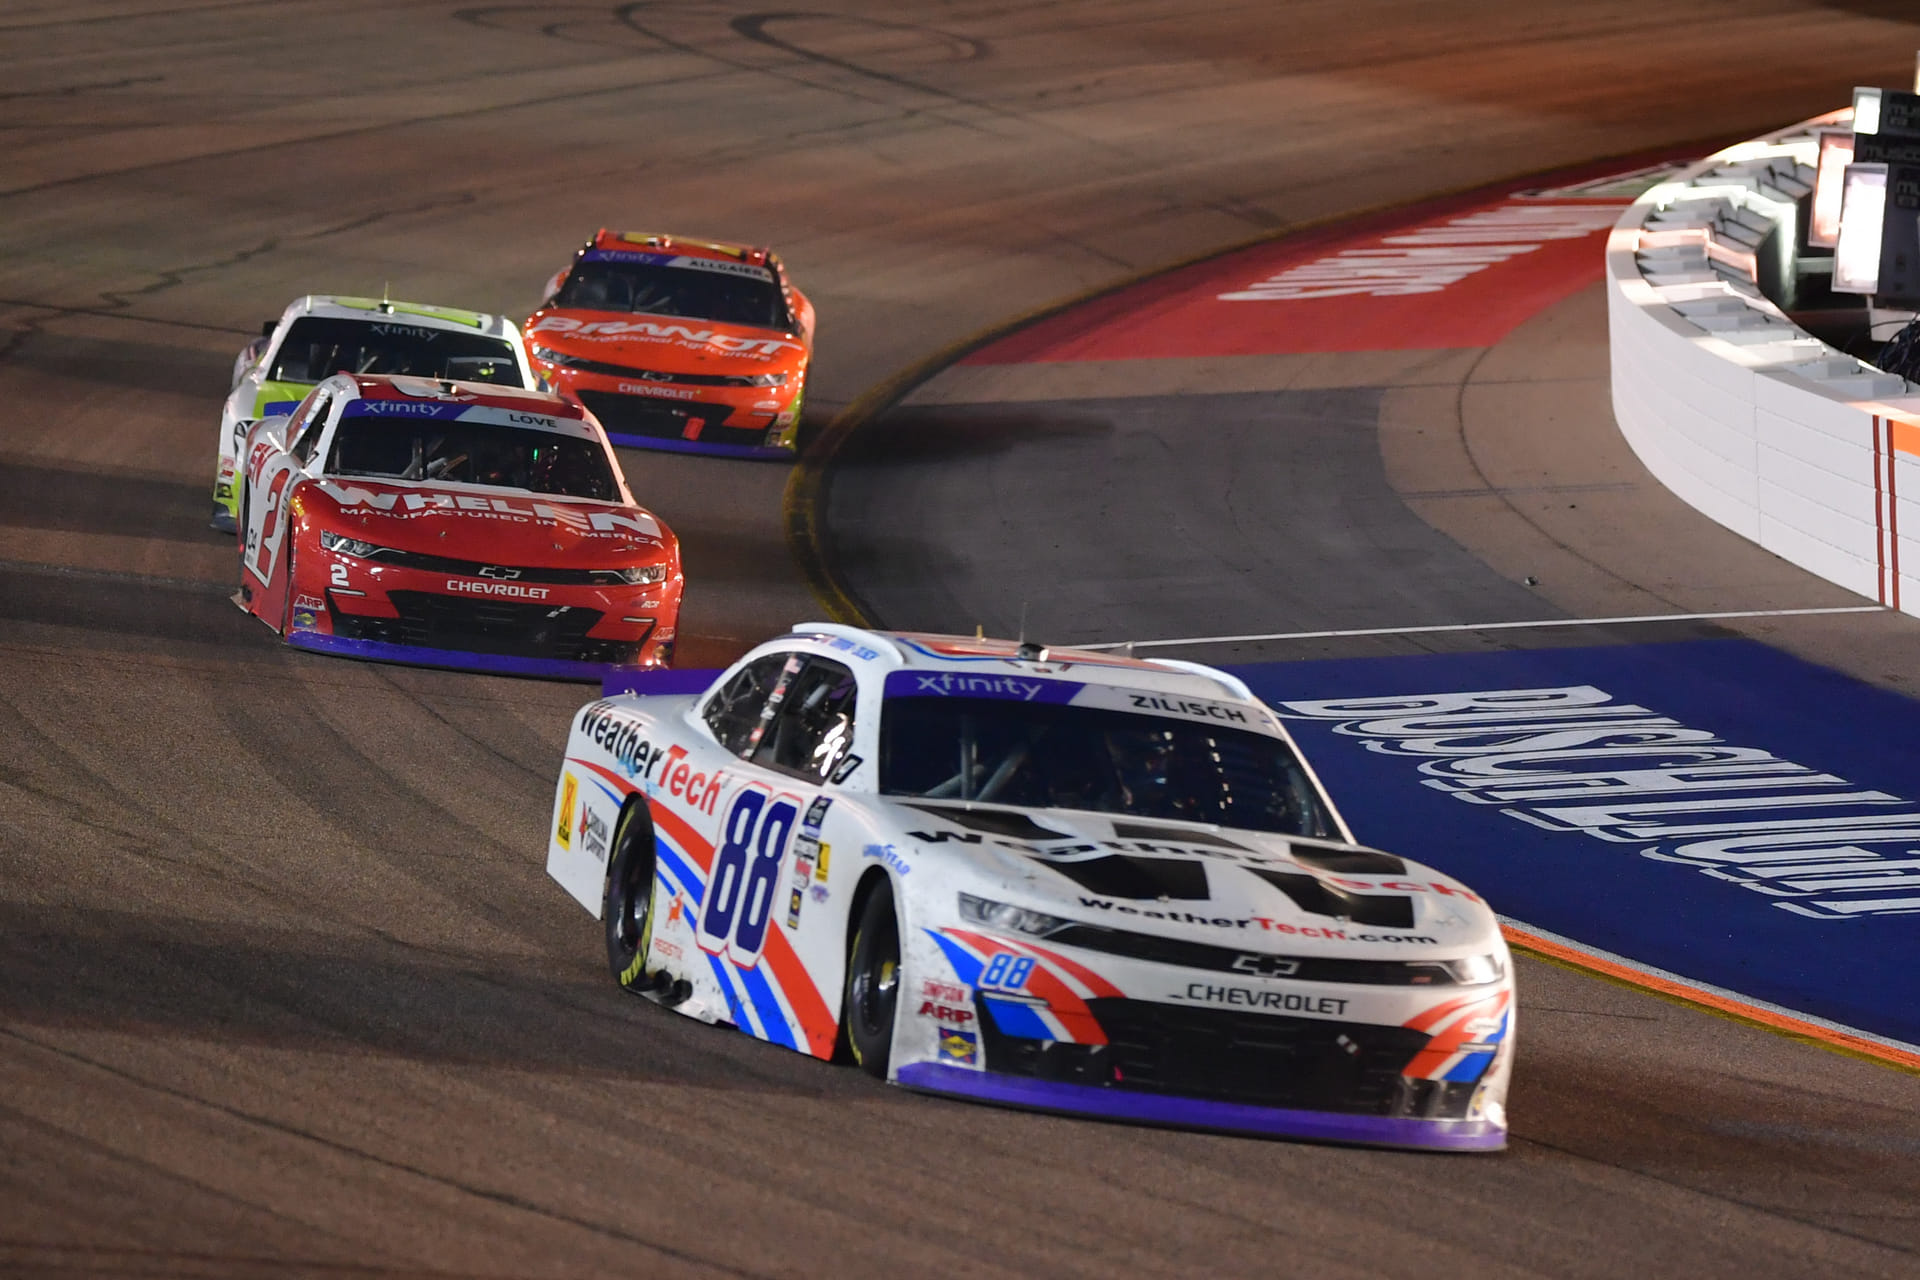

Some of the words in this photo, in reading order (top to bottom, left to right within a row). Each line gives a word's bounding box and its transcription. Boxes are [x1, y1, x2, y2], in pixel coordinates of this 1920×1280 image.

[599, 251, 656, 265] xfinity
[689, 259, 763, 277] ALLGAIER
[369, 323, 440, 343] xfinity
[534, 316, 803, 354] BRANDT
[563, 332, 672, 346] Professional
[675, 339, 771, 362] Agriculture
[618, 383, 694, 400] CHEVROLET
[363, 400, 443, 416] xfinity
[509, 413, 557, 429] LOVE
[314, 482, 663, 539] WHELEN
[340, 507, 529, 525] MANUFACTURED
[535, 518, 558, 527] IN
[565, 527, 663, 548] AMERICA
[331, 563, 350, 588] 2
[447, 580, 550, 600] CHEVROLET
[916, 671, 1043, 701] xfinity
[1129, 694, 1247, 724] ZILISCH
[580, 700, 724, 817] WeatherTech
[1274, 685, 1857, 805] BUSCH
[906, 830, 1482, 904] Weatherech
[1500, 789, 1920, 919] LIG
[704, 788, 798, 954] 88
[1079, 897, 1438, 945] WeatherTech.com
[980, 952, 1037, 989] 88
[918, 1001, 974, 1023] ARP
[1187, 983, 1348, 1016] CHEVROLET
